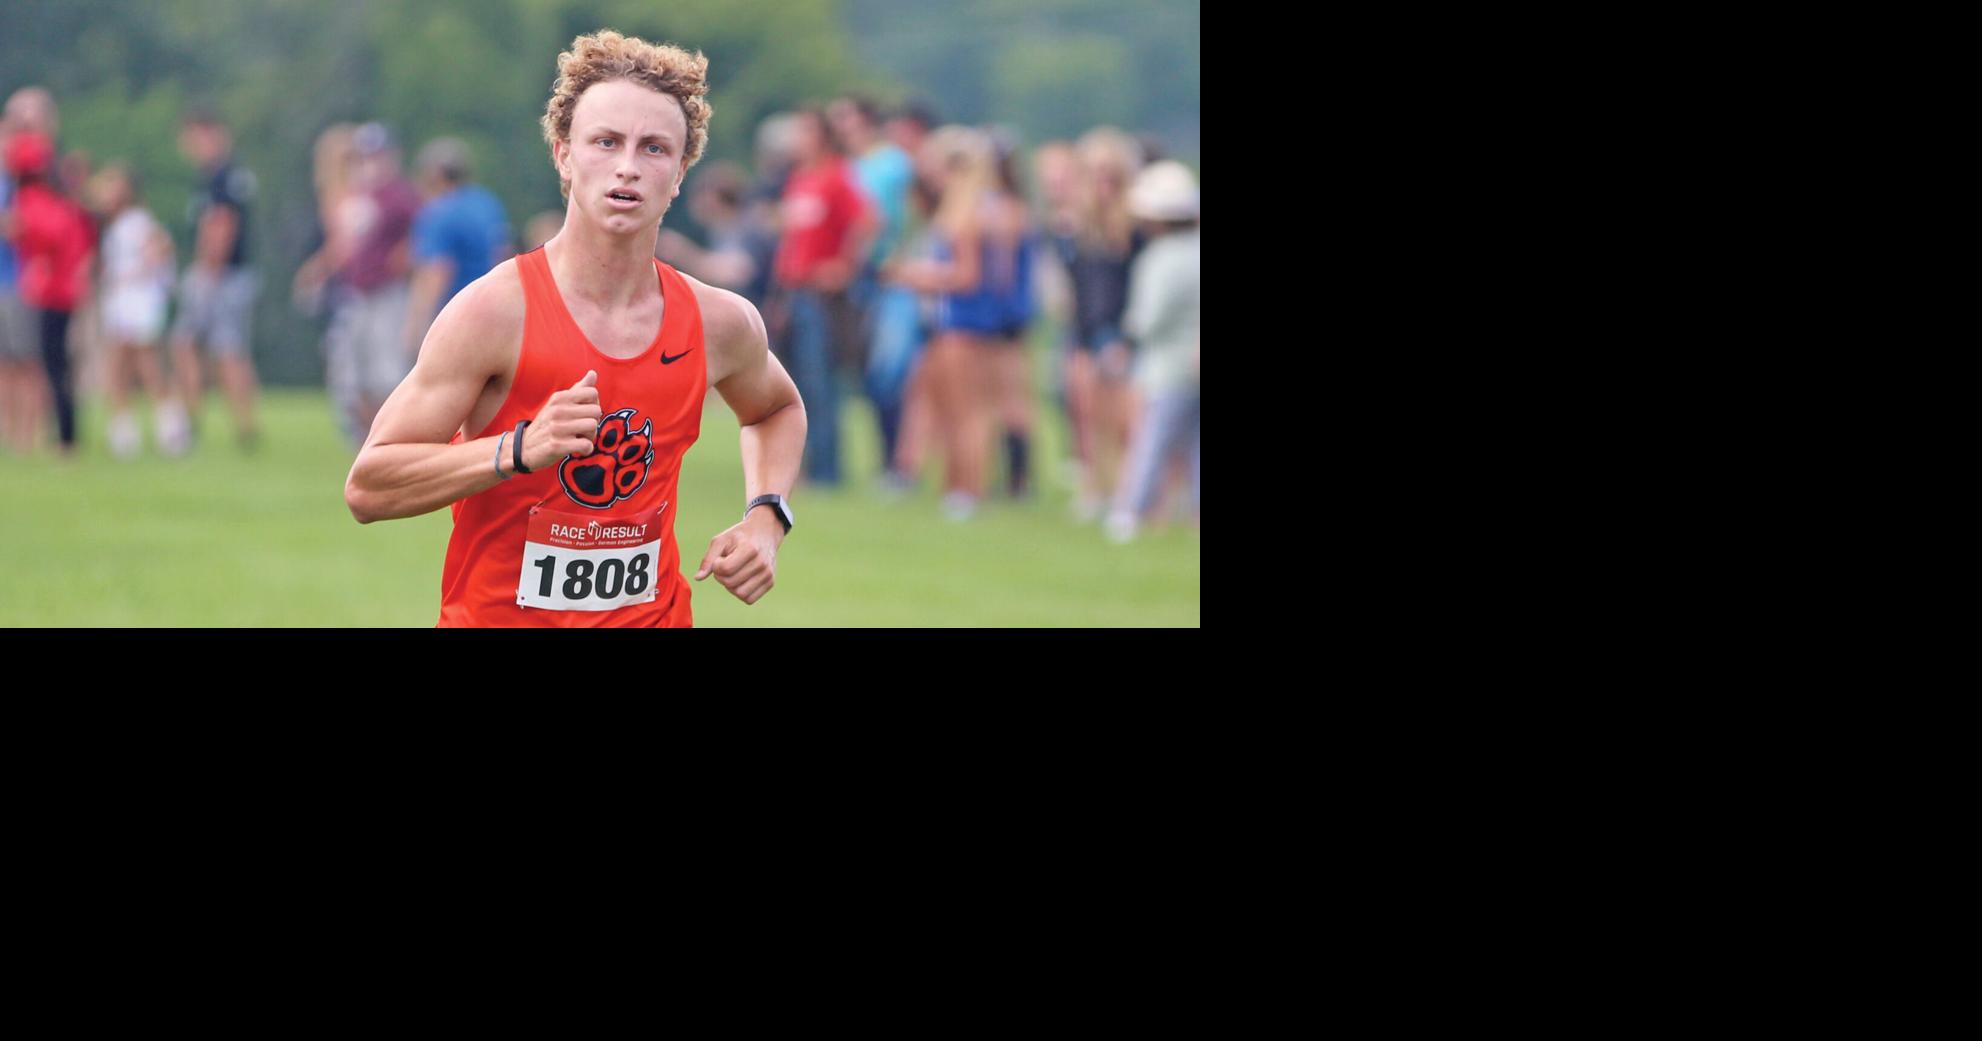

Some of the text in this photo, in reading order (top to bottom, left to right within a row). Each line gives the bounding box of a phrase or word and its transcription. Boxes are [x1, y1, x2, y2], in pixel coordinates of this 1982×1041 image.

[550, 523, 647, 540] RACE RESULT
[534, 553, 650, 600] 1808
